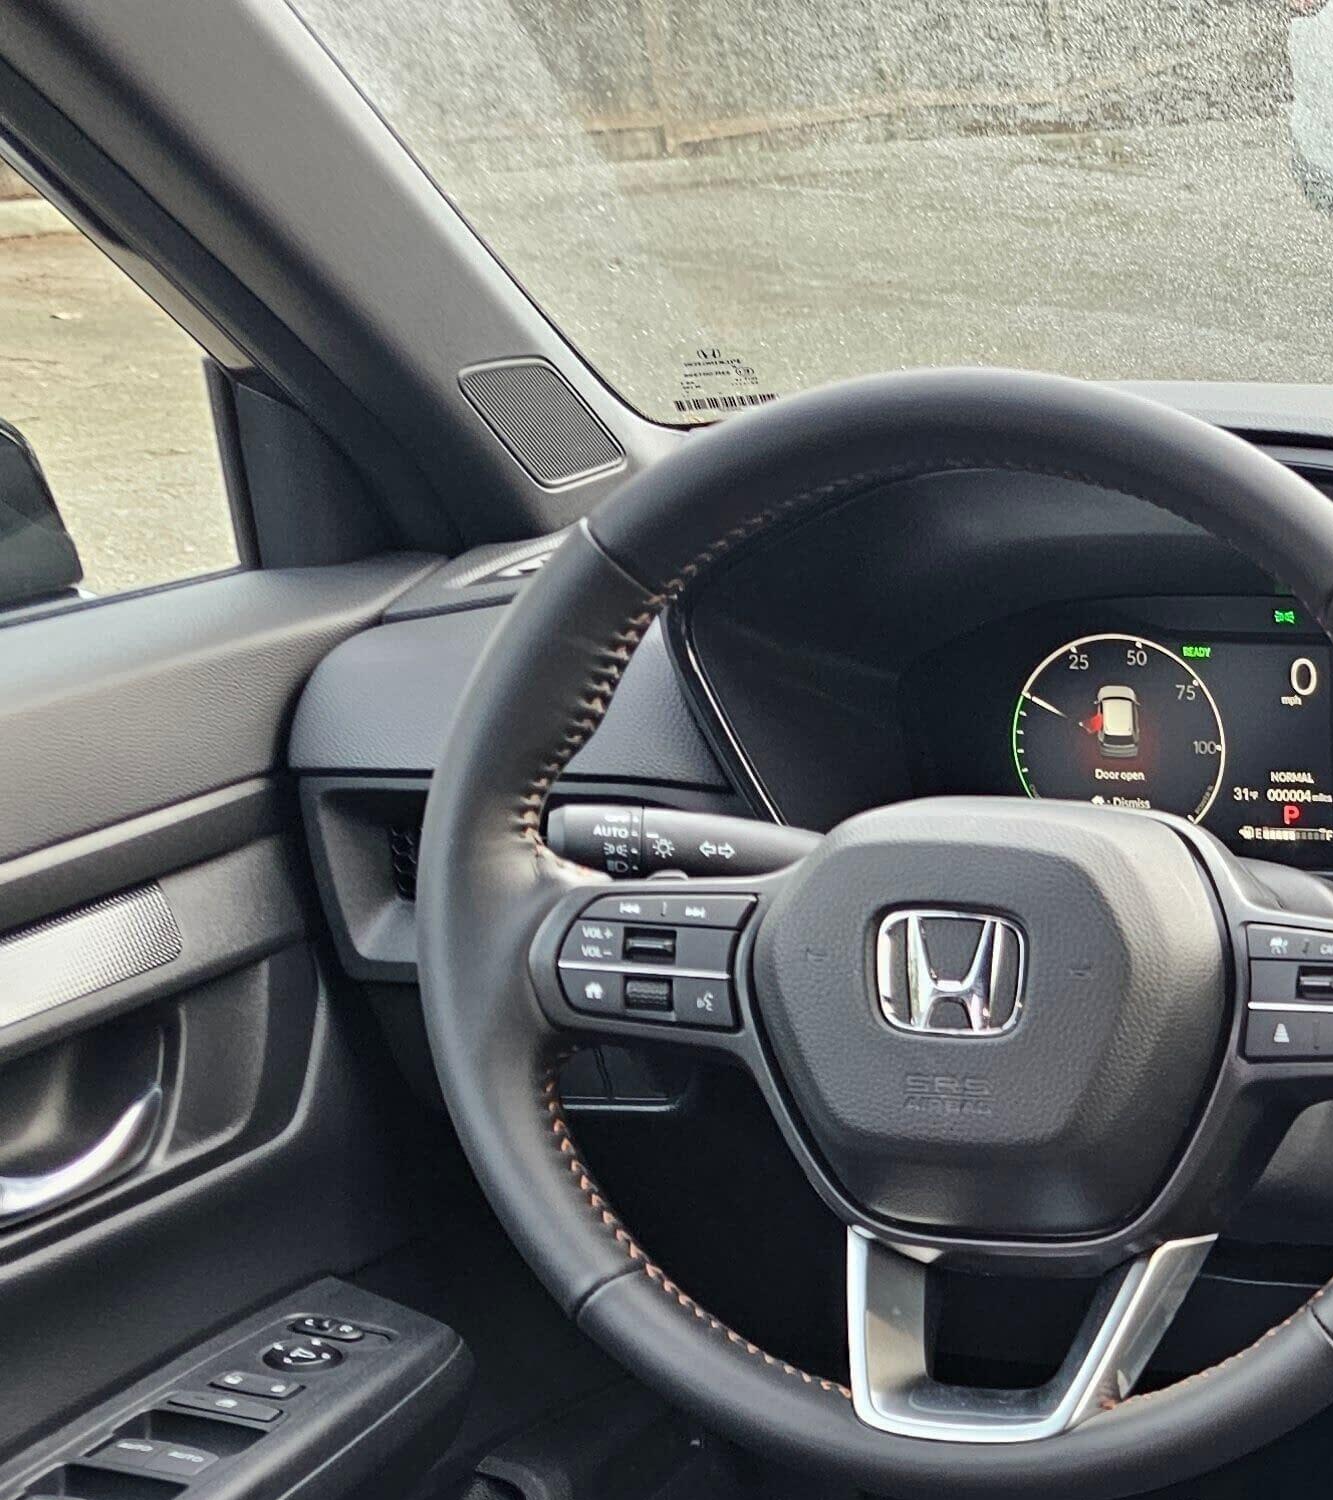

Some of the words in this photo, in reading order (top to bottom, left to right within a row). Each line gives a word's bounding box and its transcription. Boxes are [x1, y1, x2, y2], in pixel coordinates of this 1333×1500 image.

[1126, 650, 1147, 666] 50
[1183, 646, 1212, 658] READY
[1068, 654, 1089, 670] 25
[1290, 658, 1317, 695] 0
[1175, 685, 1196, 700] 75
[1281, 695, 1302, 707] mph
[1193, 740, 1217, 755] 100
[1094, 768, 1119, 780] Door
[1120, 771, 1145, 783] open
[1270, 771, 1315, 784] NORMAL
[1267, 788, 1311, 802] 000004
[1283, 805, 1300, 825] P
[593, 824, 629, 838] AUTO
[168, 1451, 204, 1463] AUTO
